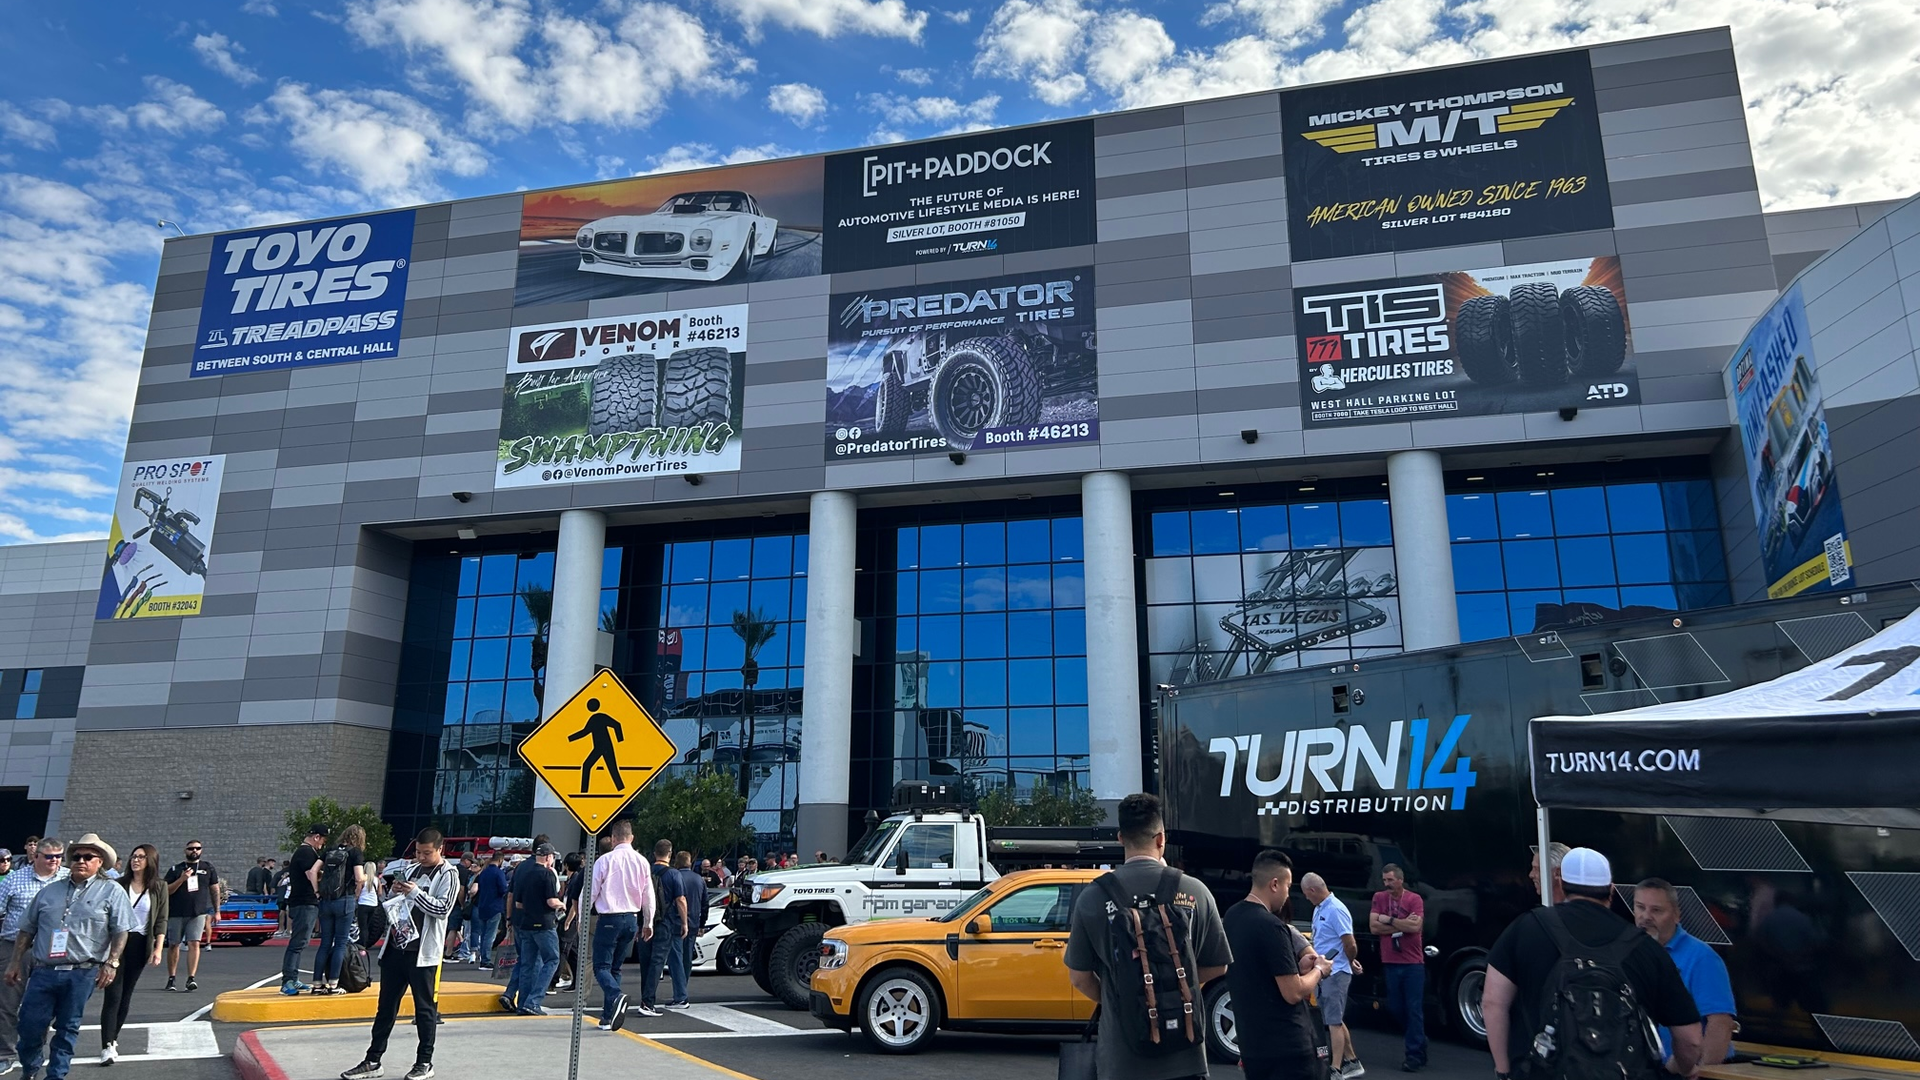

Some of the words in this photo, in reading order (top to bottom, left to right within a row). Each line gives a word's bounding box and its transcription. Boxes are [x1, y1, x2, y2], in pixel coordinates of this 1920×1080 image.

[1309, 103, 1408, 127] MICKEY
[1409, 82, 1564, 112] THOMPSON
[1376, 106, 1510, 148] M/T
[1361, 151, 1422, 167] TIRES
[1423, 150, 1438, 160] &
[1438, 139, 1518, 157] WHEELS
[910, 196, 933, 207] THE
[936, 190, 983, 204] FUTURE
[987, 187, 1004, 197] OF
[1307, 194, 1404, 229] AMERICAN
[1407, 188, 1474, 214] OWNED
[1477, 180, 1543, 206] SINCE
[1545, 175, 1587, 199] 1963
[838, 210, 915, 228] AUTOMOTIVE
[918, 203, 980, 219] LIFESTYLE
[983, 197, 1024, 210] MEDIA
[1027, 195, 1038, 205] IS
[1042, 190, 1080, 203] HERE!
[1381, 216, 1429, 230] SILVER
[1431, 213, 1456, 224] LOT
[1459, 206, 1511, 220] #84180
[891, 227, 924, 240] SILVER
[926, 225, 945, 236] LOT,
[947, 220, 982, 233] BOOTH
[983, 216, 1020, 228] #81050
[224, 222, 372, 274] TOYO
[915, 247, 940, 256] POWERED
[952, 238, 998, 252] TURN14
[231, 260, 396, 314] TIRES
[863, 280, 1074, 324] PREDATOR
[689, 315, 723, 328] Booth
[1015, 306, 1075, 323] TIRES
[232, 310, 398, 346] TREADPASS
[580, 317, 681, 347] VENOM
[687, 326, 740, 343] #46213
[861, 326, 907, 338] PURSUIT
[908, 324, 924, 333] OF
[925, 316, 1006, 332] PERFORMANCE
[580, 340, 680, 358] POWER
[1343, 324, 1450, 359] TIRES
[196, 356, 255, 371] BETWEEN
[252, 351, 292, 365] SOUTH
[294, 351, 304, 361] &
[306, 345, 360, 360] CENTRAL
[362, 341, 393, 354] HALL
[1340, 362, 1411, 383] HERCULES
[1411, 359, 1454, 378] TIRES
[1744, 305, 1798, 459] UNLEASHED
[1310, 399, 1341, 410] WEST
[1346, 396, 1374, 407] HALL
[1378, 392, 1430, 405] PARKING
[1435, 390, 1456, 400] LOT
[1586, 382, 1629, 400] ATD
[1418, 403, 1437, 411] WEST
[1437, 402, 1455, 410] HALL
[985, 429, 1024, 444] Booth
[1027, 422, 1090, 441] #46213
[835, 436, 947, 455] @PredatorTires
[133, 464, 167, 481] PRO
[169, 461, 212, 478] SPOT
[564, 460, 688, 479] @VenomPowerTires
[148, 602, 171, 612] BOOTH
[172, 600, 198, 611] #32043
[1241, 613, 1272, 627] LAS
[1278, 610, 1342, 625] VEGAS
[1208, 714, 1478, 810] TURN14
[1545, 748, 1701, 773] TURN14.COM
[1287, 795, 1447, 815] DISTRIBUTION
[863, 899, 899, 914] rpm
[902, 899, 963, 914] garag
